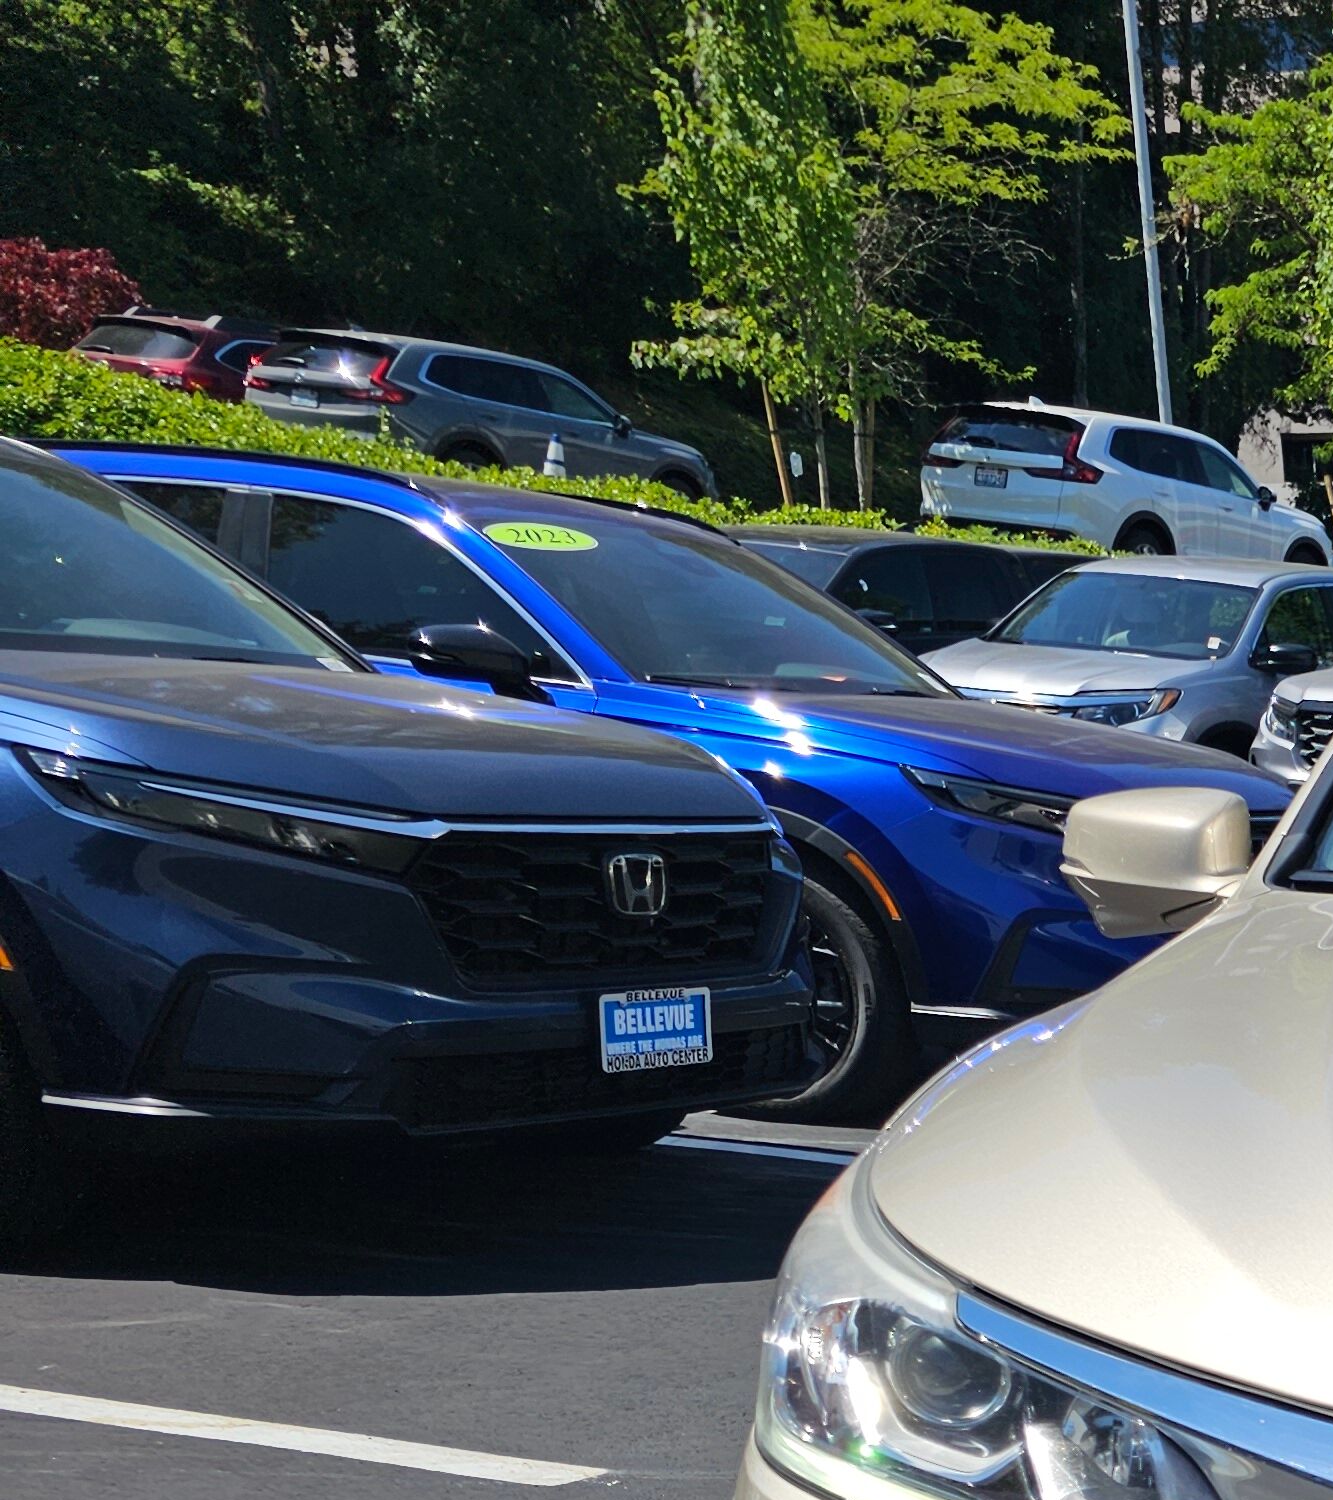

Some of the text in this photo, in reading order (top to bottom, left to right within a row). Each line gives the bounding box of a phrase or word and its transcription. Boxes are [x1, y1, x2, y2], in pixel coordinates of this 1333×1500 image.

[506, 528, 577, 544] 2023
[626, 988, 685, 1002] BELLEVUE
[614, 1004, 694, 1035] BELLEVUE
[607, 1048, 709, 1071] HONDA AUTO CENTER
